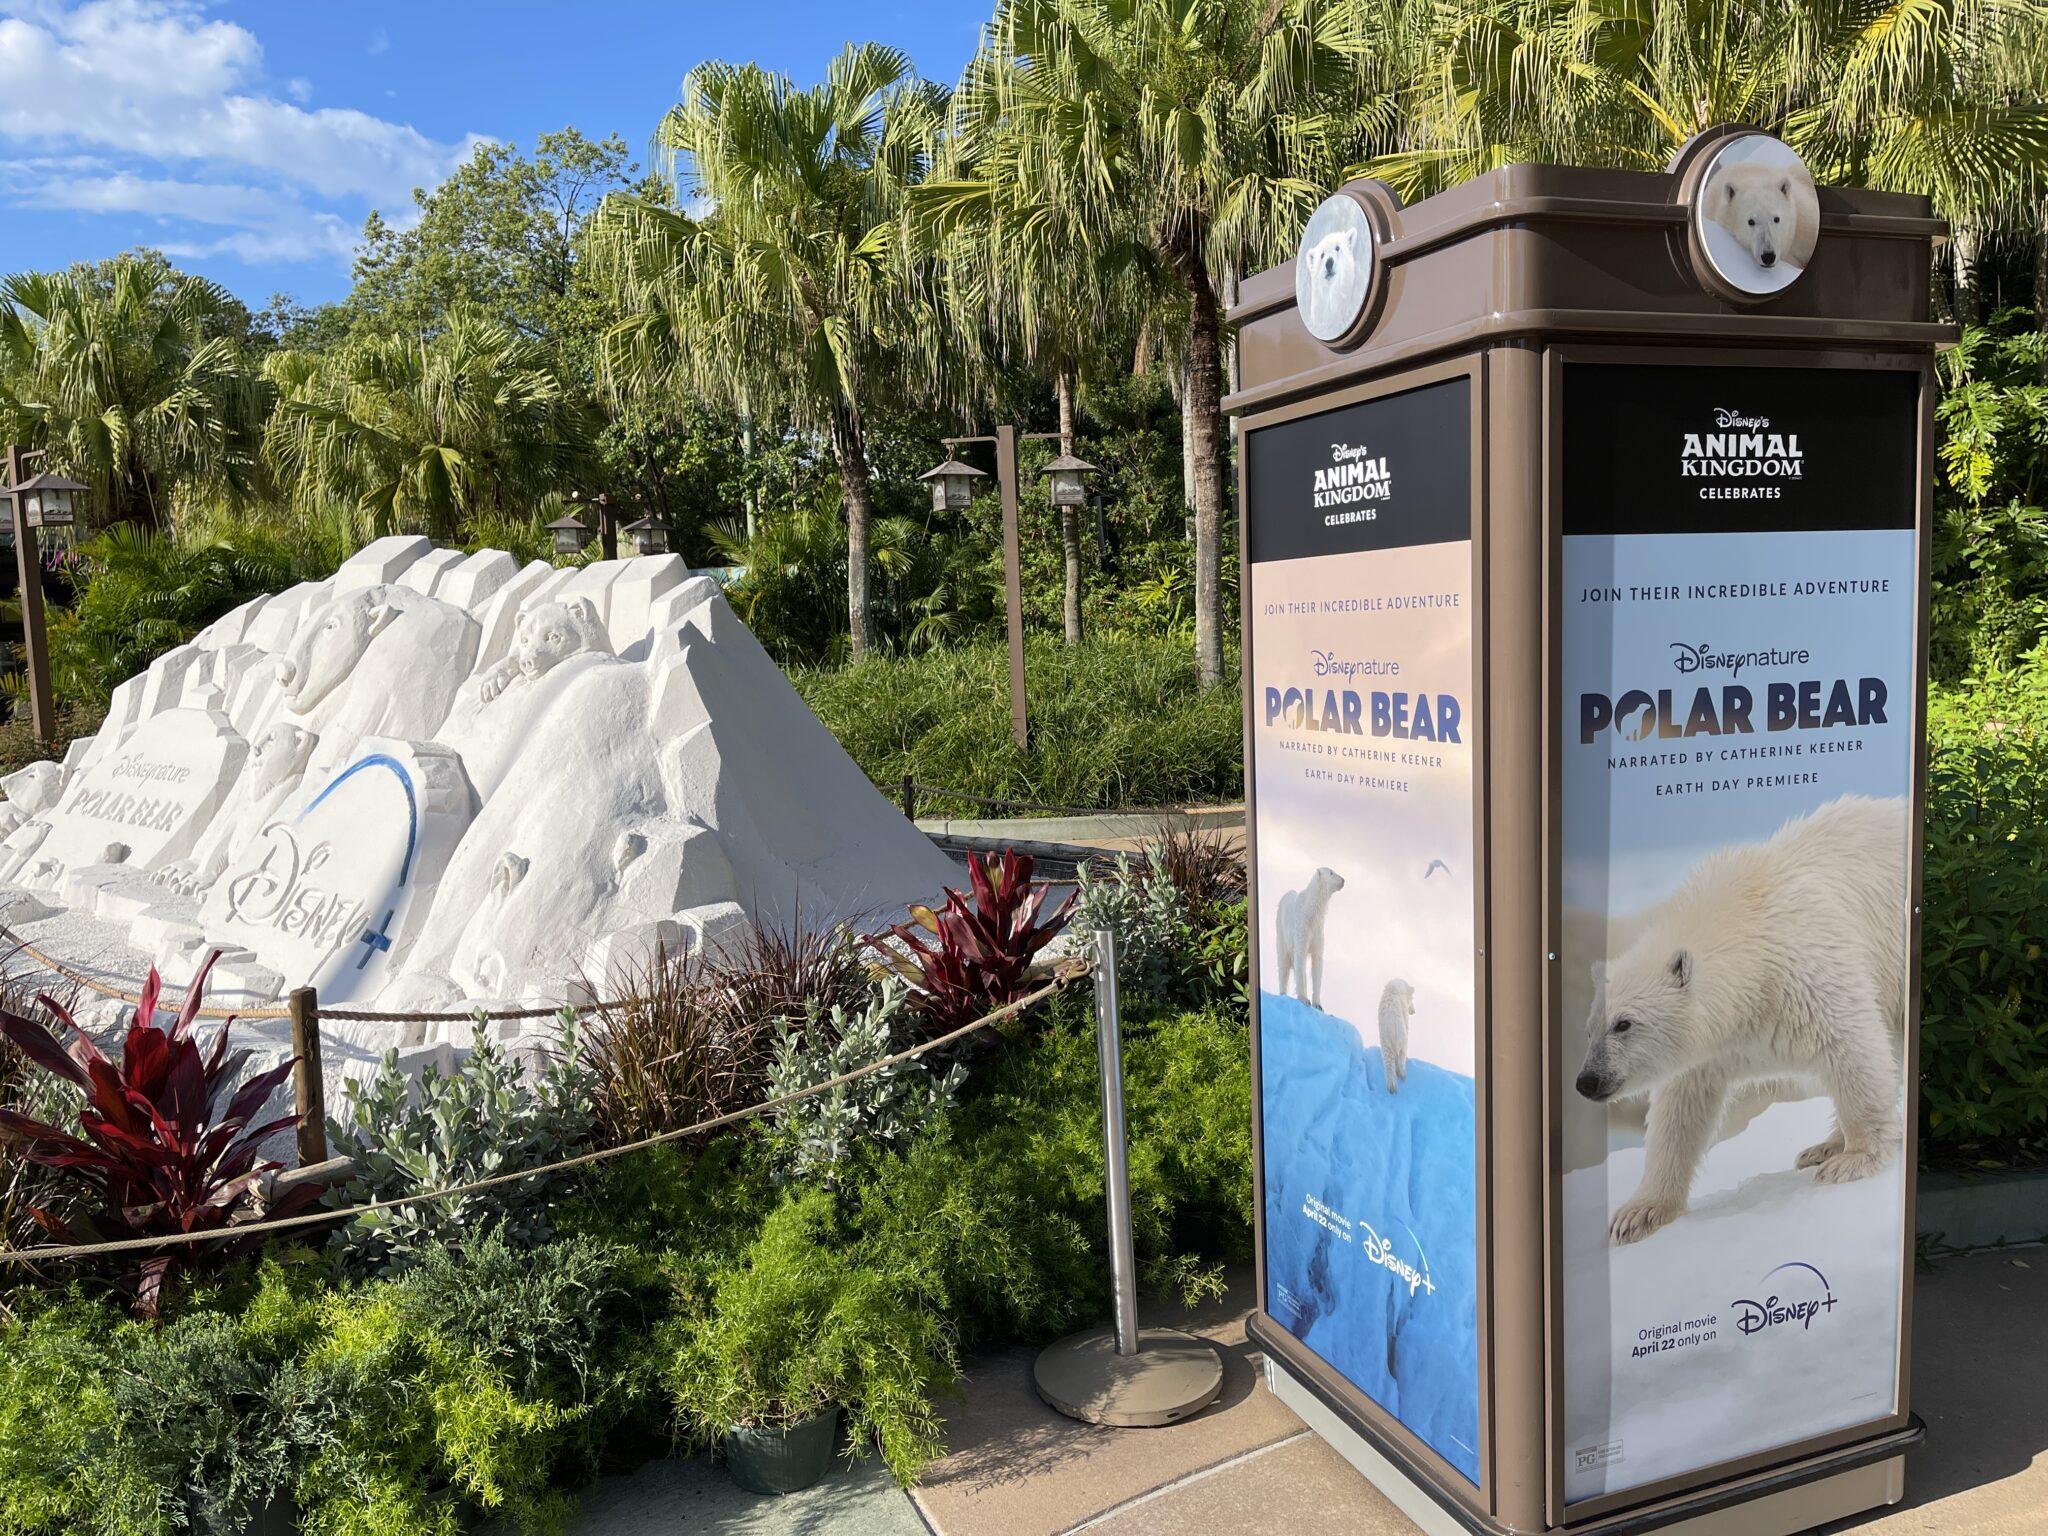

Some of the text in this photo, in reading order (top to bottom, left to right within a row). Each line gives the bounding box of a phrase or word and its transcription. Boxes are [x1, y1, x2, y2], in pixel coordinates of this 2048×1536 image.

[1714, 407, 1769, 434] Disney's
[1331, 443, 1367, 463] Disney's
[1682, 433, 1803, 458] ANIMAL
[1314, 457, 1391, 492] ANIMAL
[1681, 459, 1803, 477] KINGDOM
[1314, 481, 1391, 508] KINGDOM
[1699, 487, 1781, 500] CELEBRATES
[1325, 508, 1377, 526] CELEBRATES
[1581, 579, 1890, 602] JOIN THEIR INCREDIBLE ADVENTURE
[1264, 593, 1460, 616] JOIN THEIR INCREDIBLE ADVENTURE
[1265, 686, 1462, 744] POLAR BEAR
[1580, 677, 1888, 745] POLAR BEAR
[1279, 740, 1442, 768] NARRATED BY CATHERINE KEENER
[1607, 740, 1864, 770] NARRATED BY CATHERINE KEENER
[1305, 768, 1409, 792] EARTH DAY PREMIERE
[1656, 773, 1819, 797] EARTH DAY PREMIERE
[64, 787, 184, 832] POLAR BEAR
[1302, 1204, 1352, 1243] April 22 only on
[1306, 1193, 1352, 1230] Original movie
[1359, 1221, 1436, 1298] Disney+
[1638, 1313, 1718, 1341] Original movie
[1731, 1291, 1838, 1336] Disney+
[1631, 1329, 1718, 1358] April 22 only on
[1576, 1453, 1596, 1467] PG
